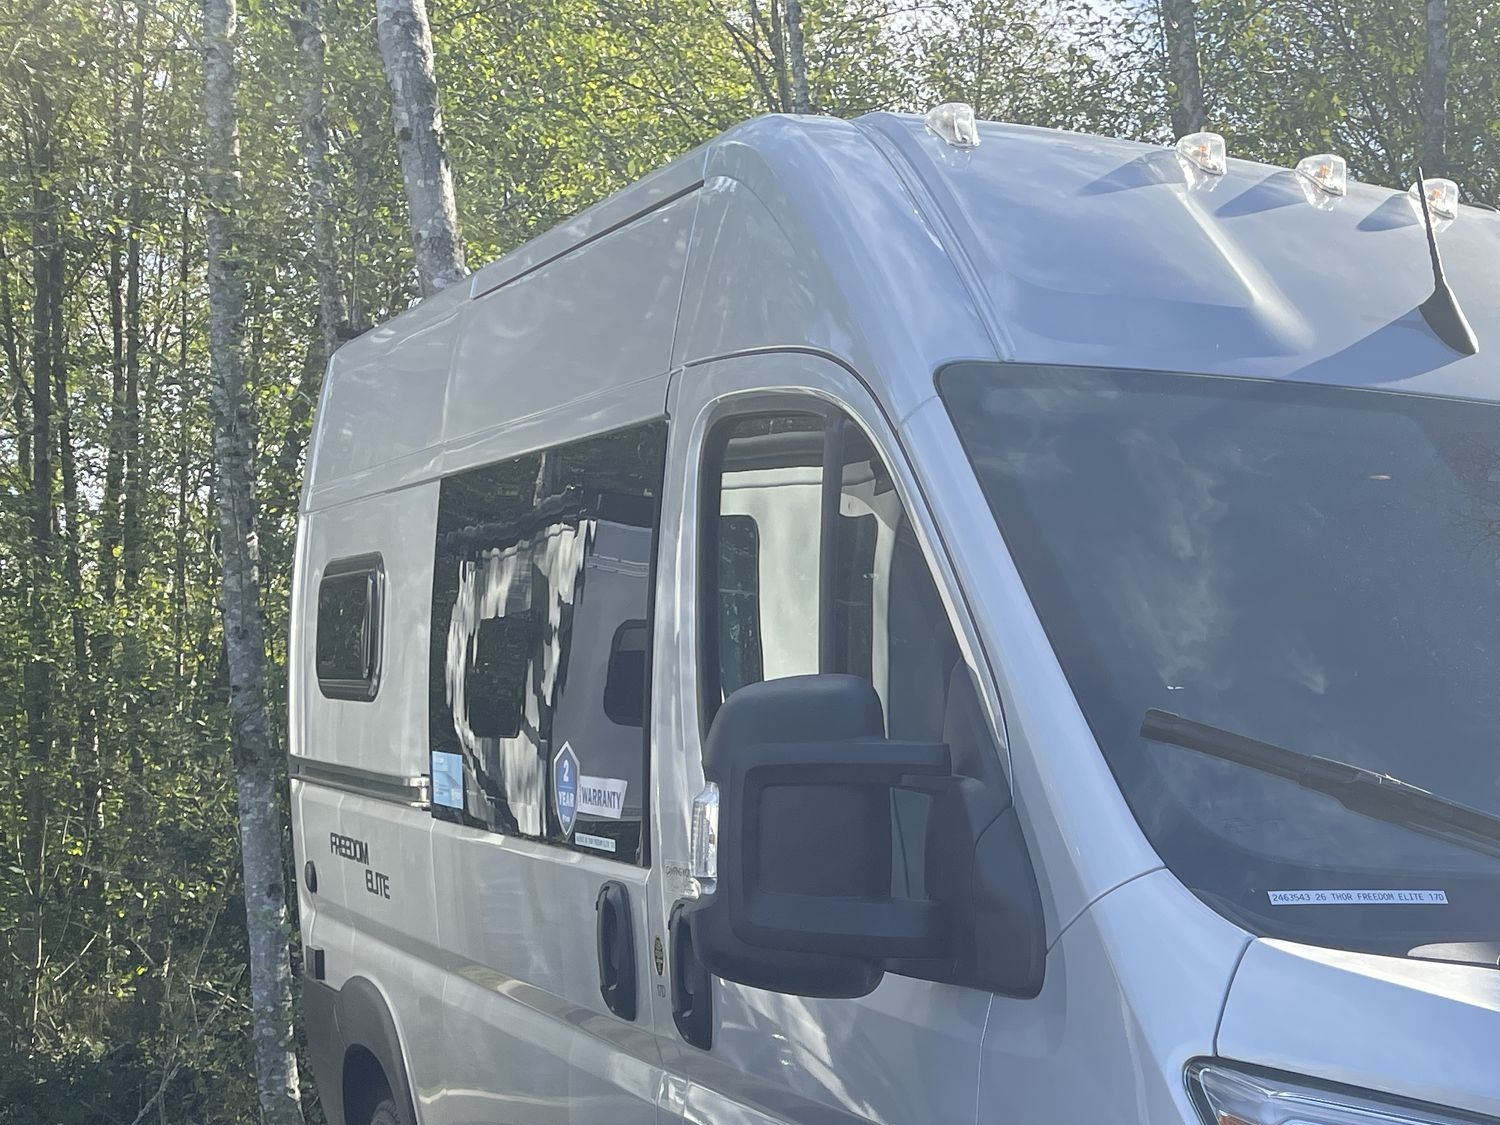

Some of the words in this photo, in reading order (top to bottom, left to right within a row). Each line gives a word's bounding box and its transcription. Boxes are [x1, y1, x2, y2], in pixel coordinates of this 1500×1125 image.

[563, 760, 570, 782] 2
[558, 791, 575, 807] YEAR
[581, 786, 622, 810] WARRANTY
[330, 832, 369, 866] FREEDOM
[365, 869, 391, 900] ELITE
[1315, 893, 1327, 901] 26
[1331, 892, 1354, 901] THOR
[1356, 892, 1396, 901] FREEDOM
[1398, 892, 1425, 901] ELITE
